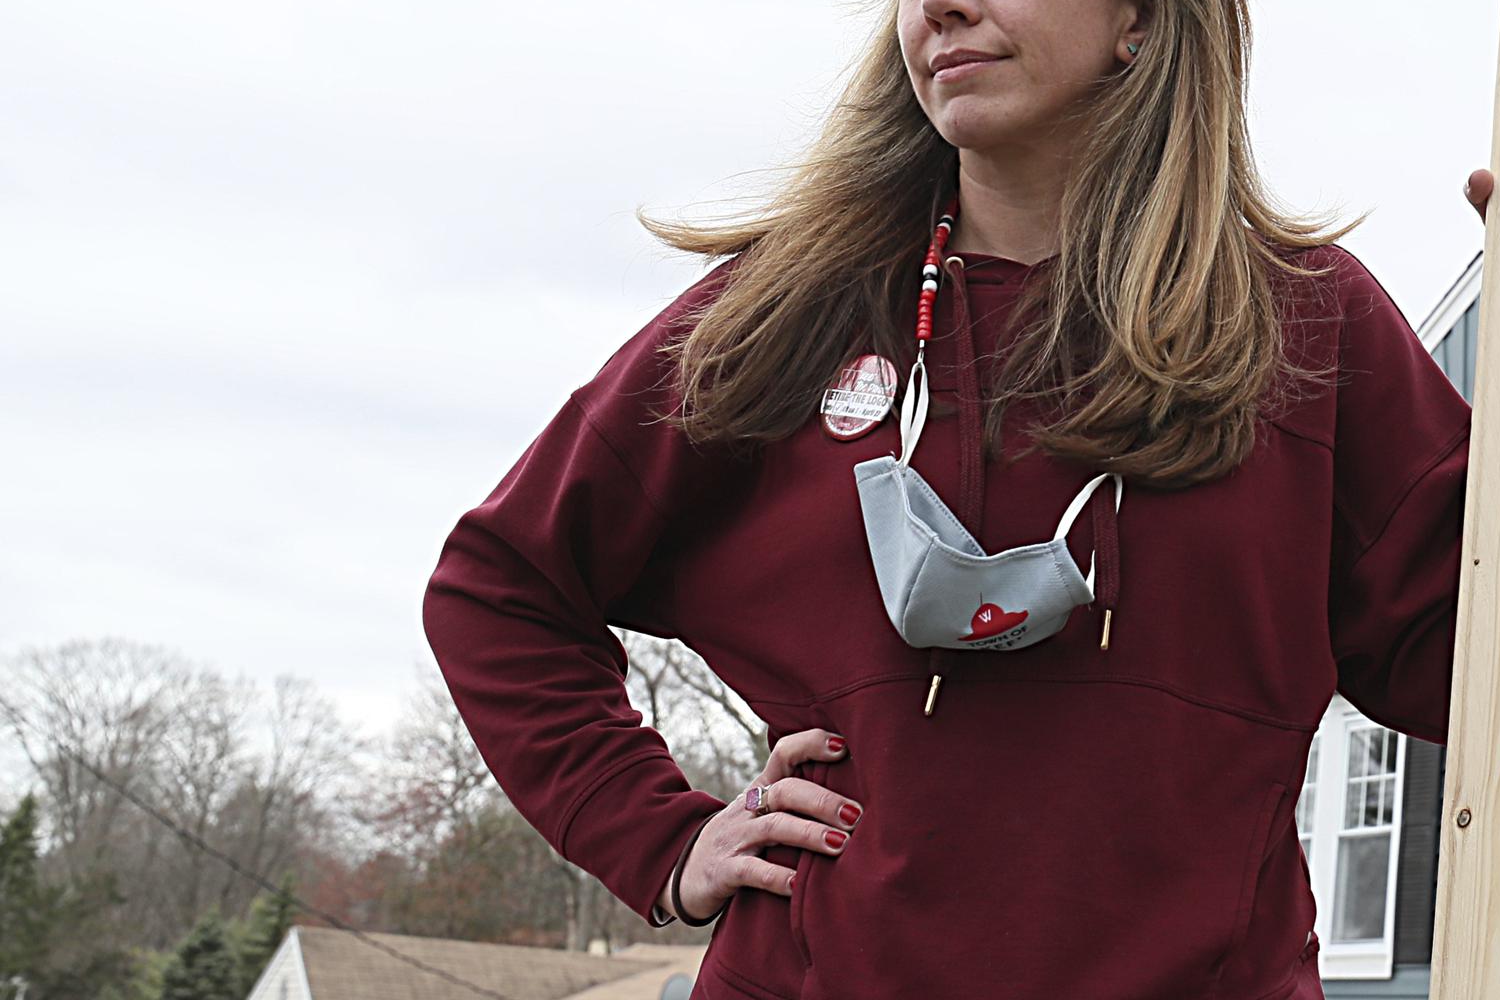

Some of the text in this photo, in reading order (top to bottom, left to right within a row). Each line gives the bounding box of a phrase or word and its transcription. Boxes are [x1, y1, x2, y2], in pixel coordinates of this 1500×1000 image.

[978, 608, 992, 624] W
[969, 634, 1008, 648] TOWN
[1010, 625, 1027, 637] OF
